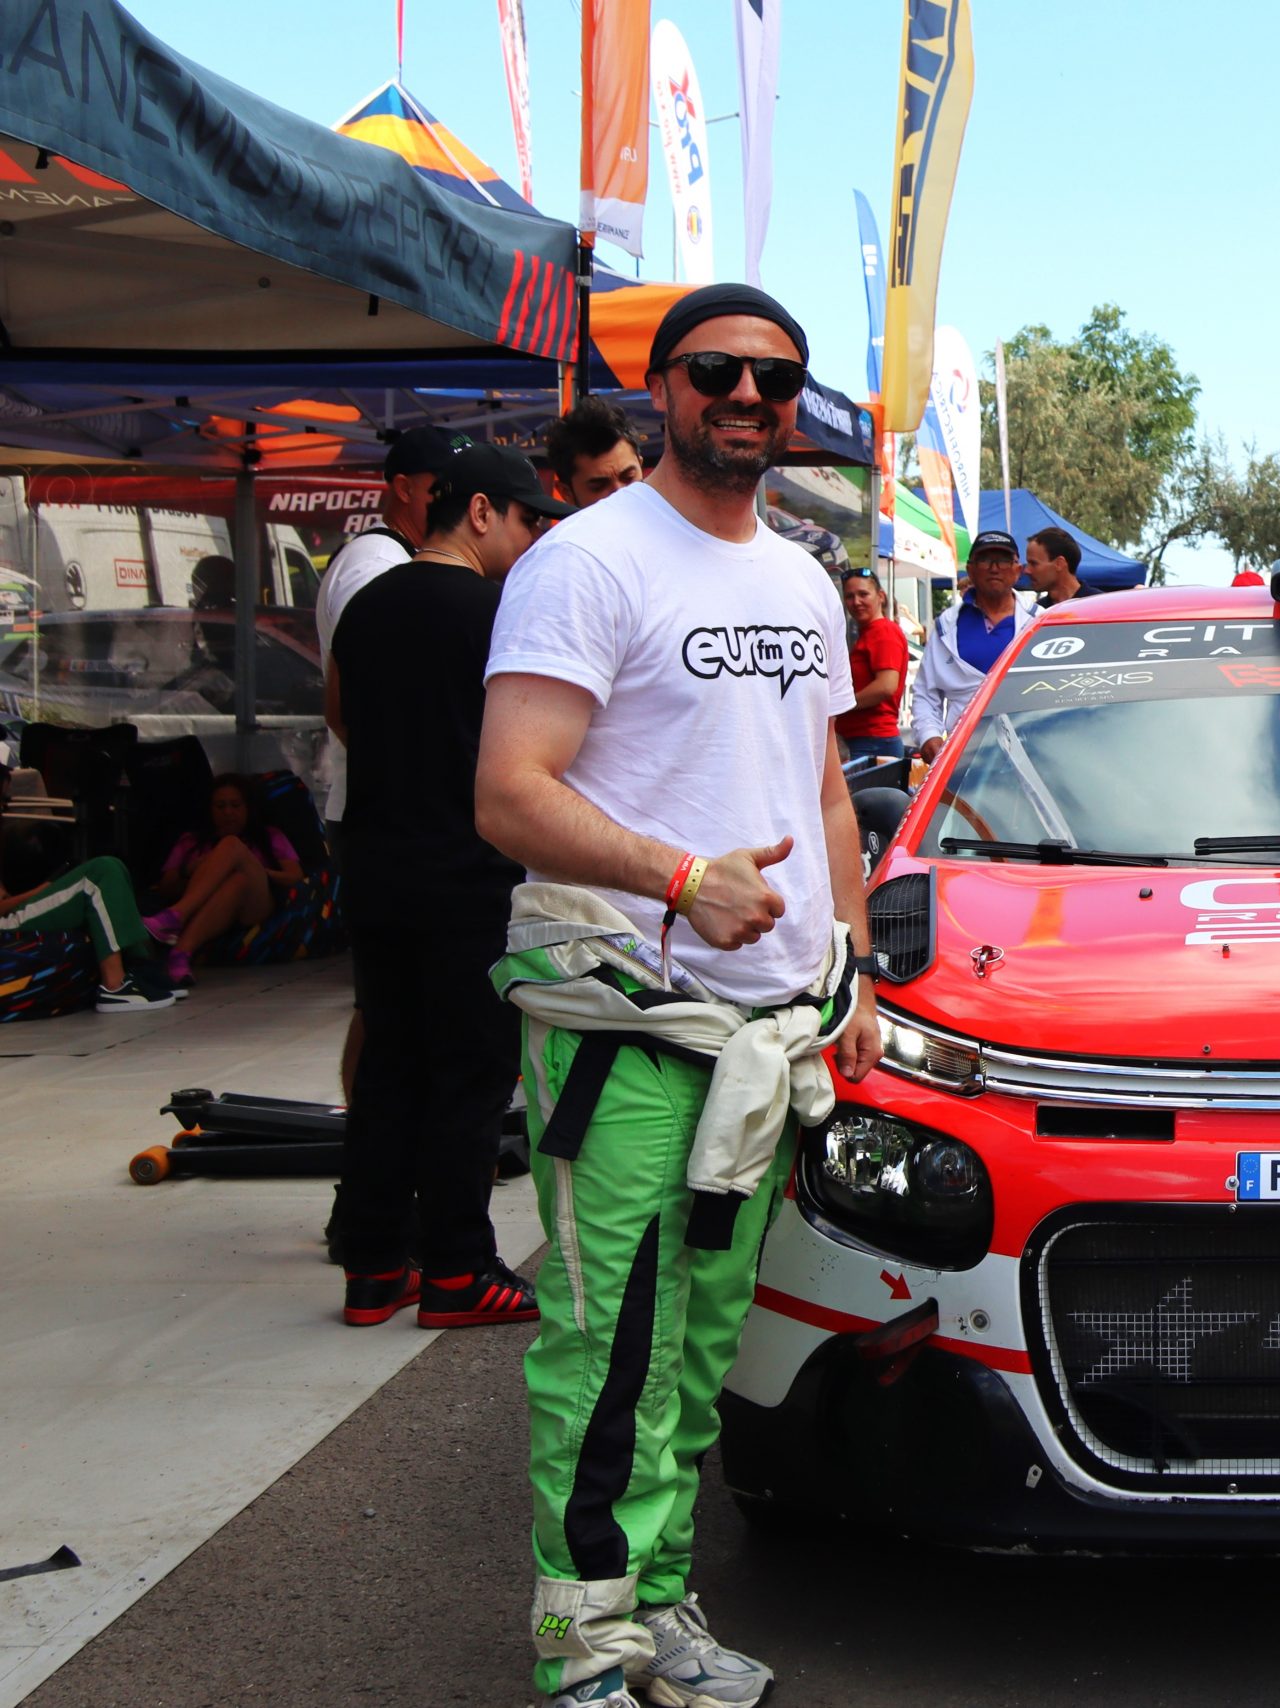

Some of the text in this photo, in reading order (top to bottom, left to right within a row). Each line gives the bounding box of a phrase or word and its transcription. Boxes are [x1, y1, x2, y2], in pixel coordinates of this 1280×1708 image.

[269, 489, 382, 512] NAPOCA
[757, 639, 783, 660] fm
[1043, 640, 1072, 655] 16
[1246, 1180, 1254, 1191] F
